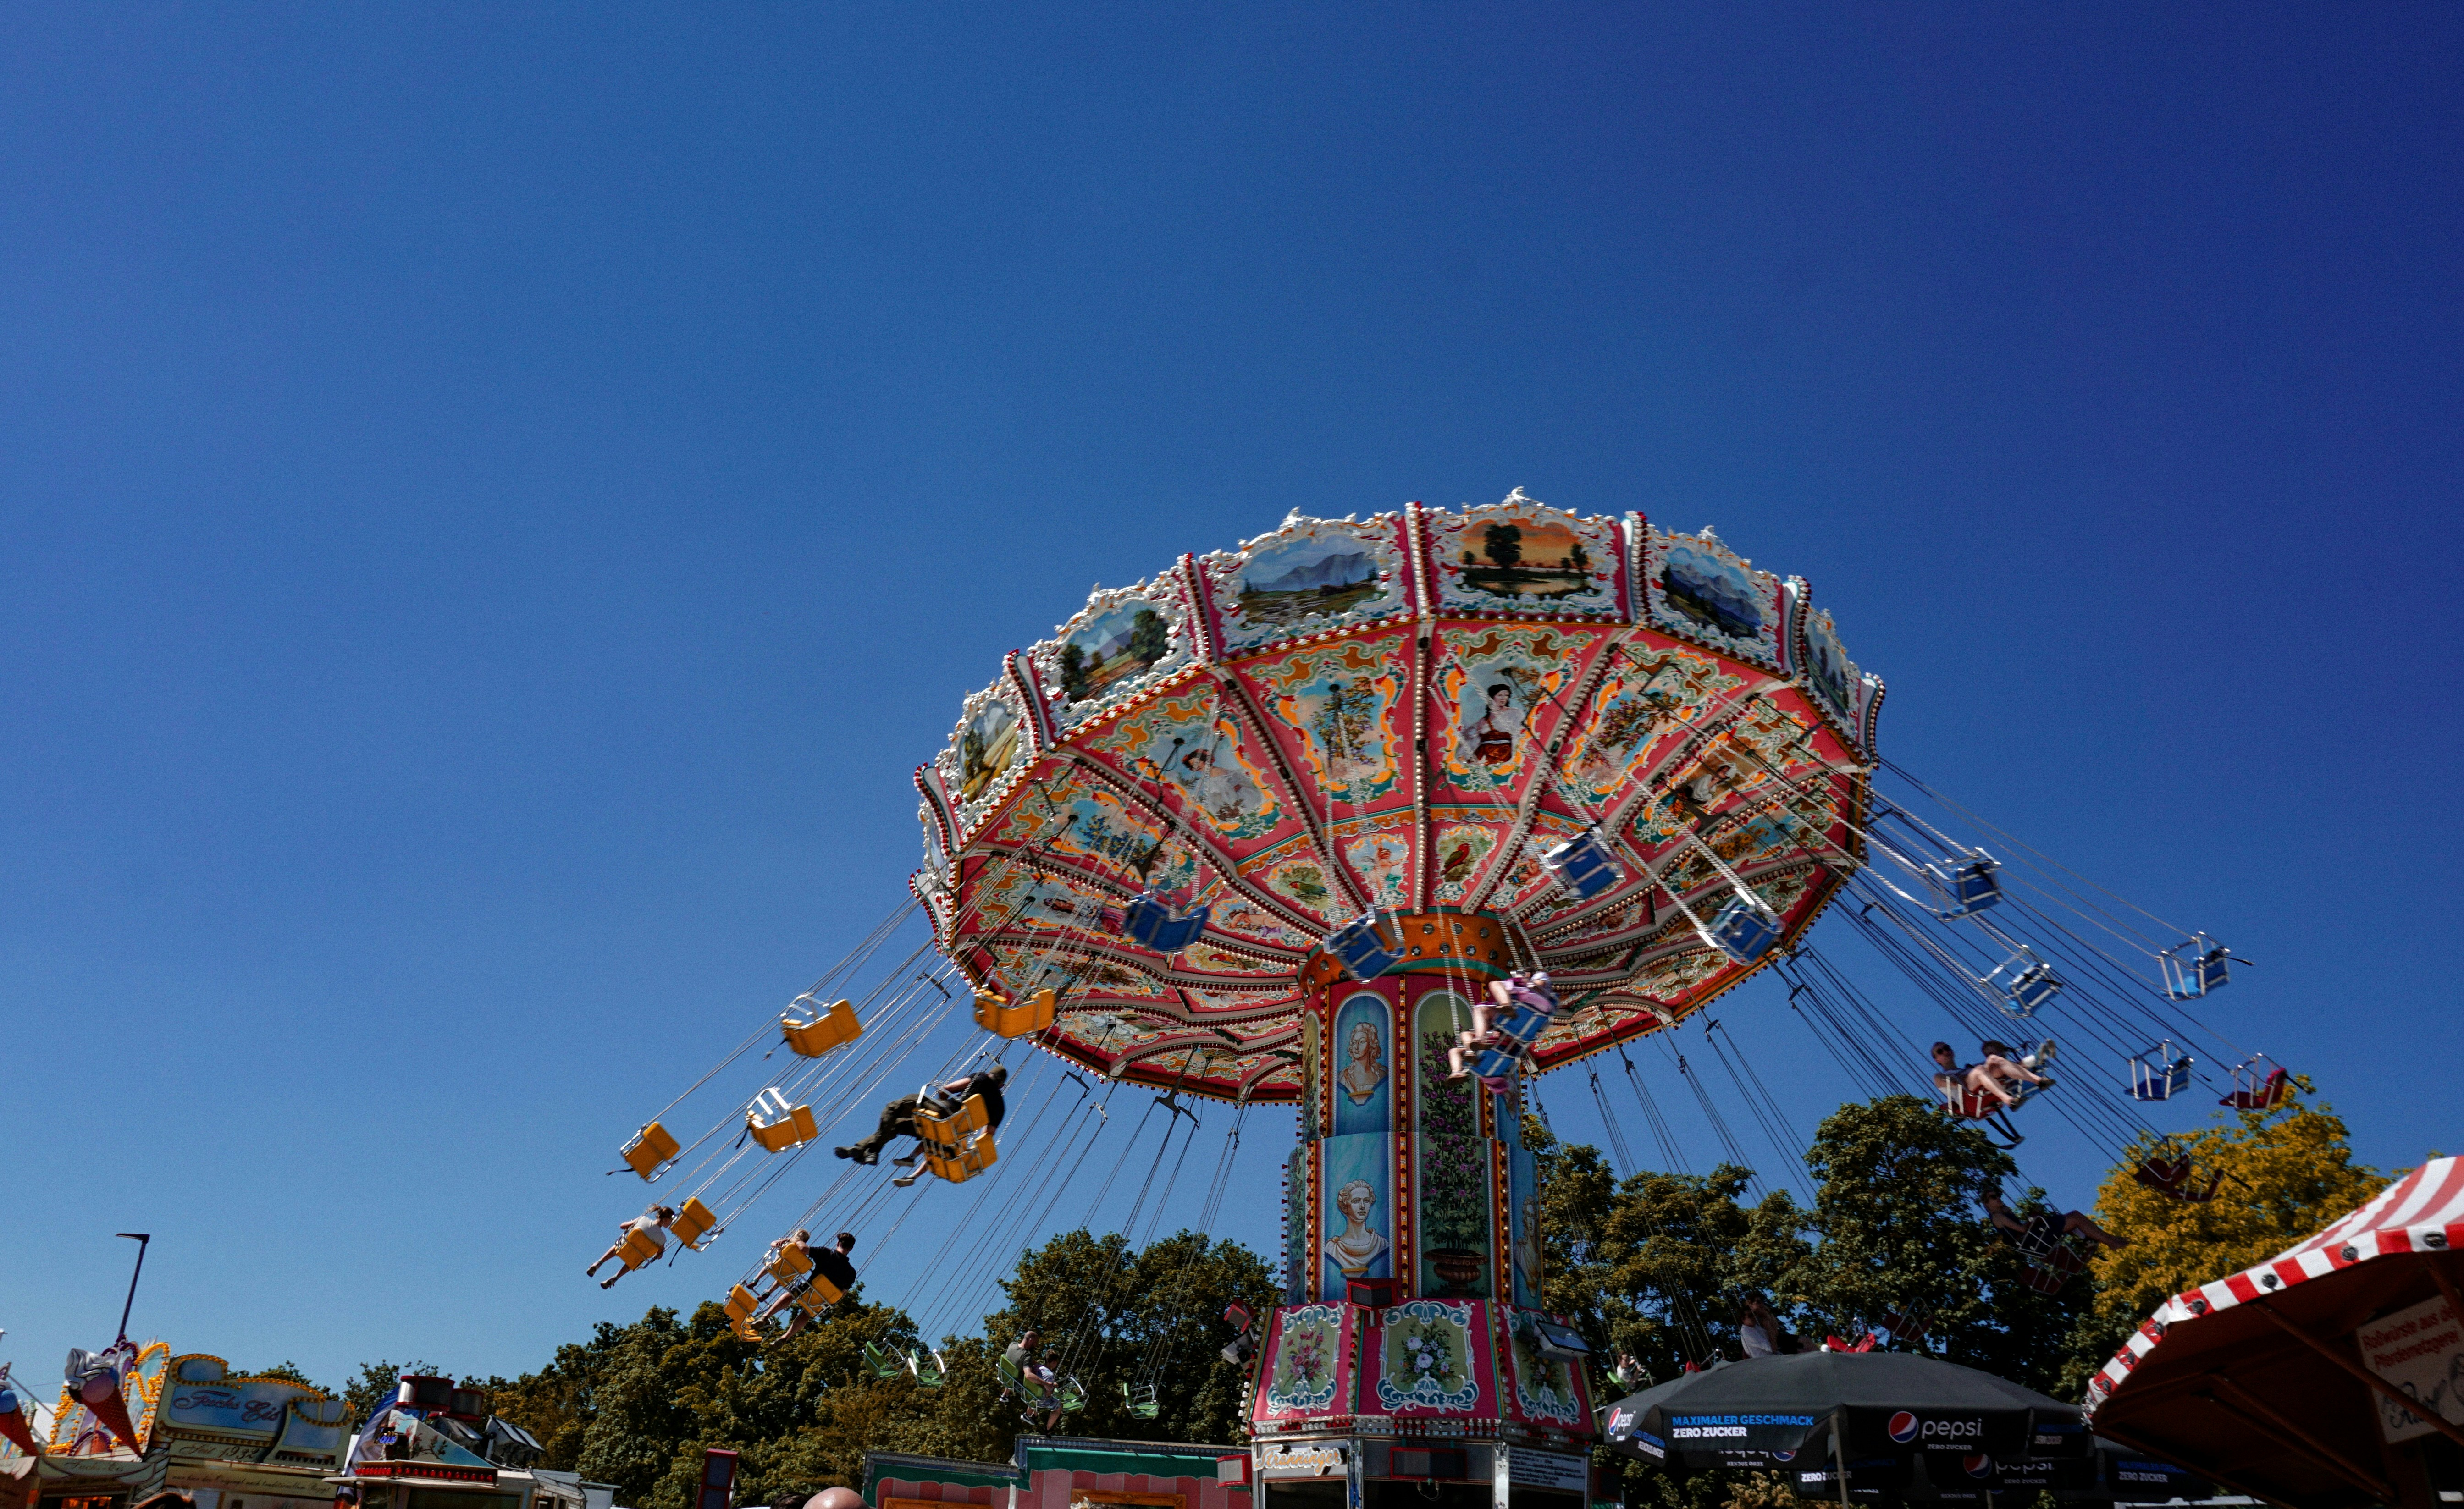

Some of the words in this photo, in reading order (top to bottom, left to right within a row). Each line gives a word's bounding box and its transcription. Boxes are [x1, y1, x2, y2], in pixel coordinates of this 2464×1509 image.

[173, 1390, 241, 1409] Fuchs
[241, 1400, 282, 1422] Eis
[1672, 1415, 1738, 1426] MAXIMALER
[1740, 1415, 1814, 1426] GESCHMACK
[1673, 1427, 1701, 1438] ZERO
[1702, 1426, 1747, 1437] ZUCKER
[1921, 1418, 1982, 1439] pepsi
[218, 1445, 259, 1459] 1932
[1254, 1444, 1342, 1476] Stranninger
[1801, 1472, 1822, 1482] ZERO
[1822, 1470, 1852, 1481] ZUCER
